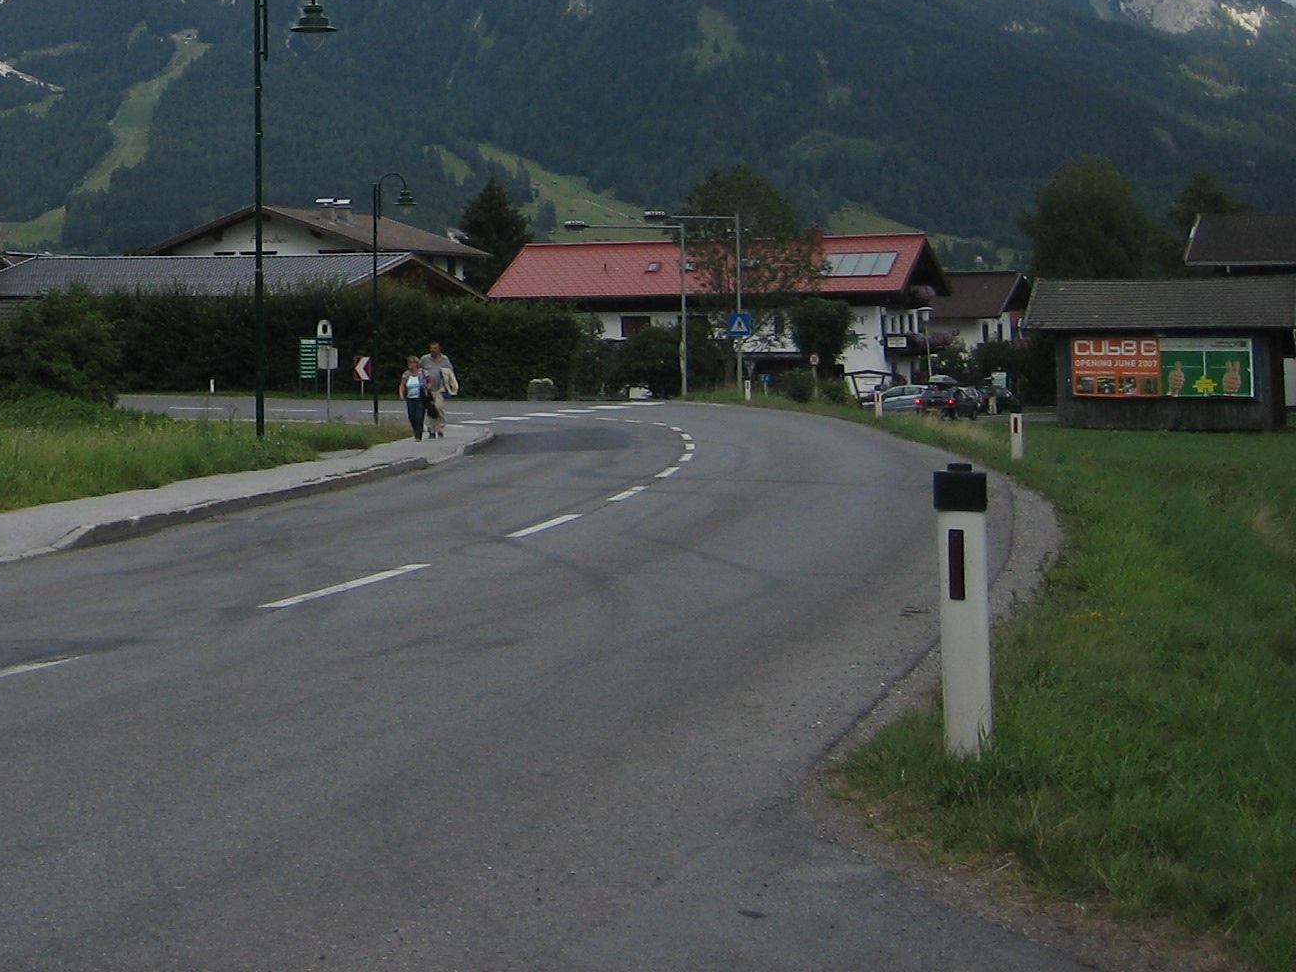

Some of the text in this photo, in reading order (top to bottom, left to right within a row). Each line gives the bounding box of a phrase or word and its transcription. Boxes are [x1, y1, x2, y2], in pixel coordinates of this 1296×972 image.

[1074, 359, 1158, 367] OPENING JUNE 2007
